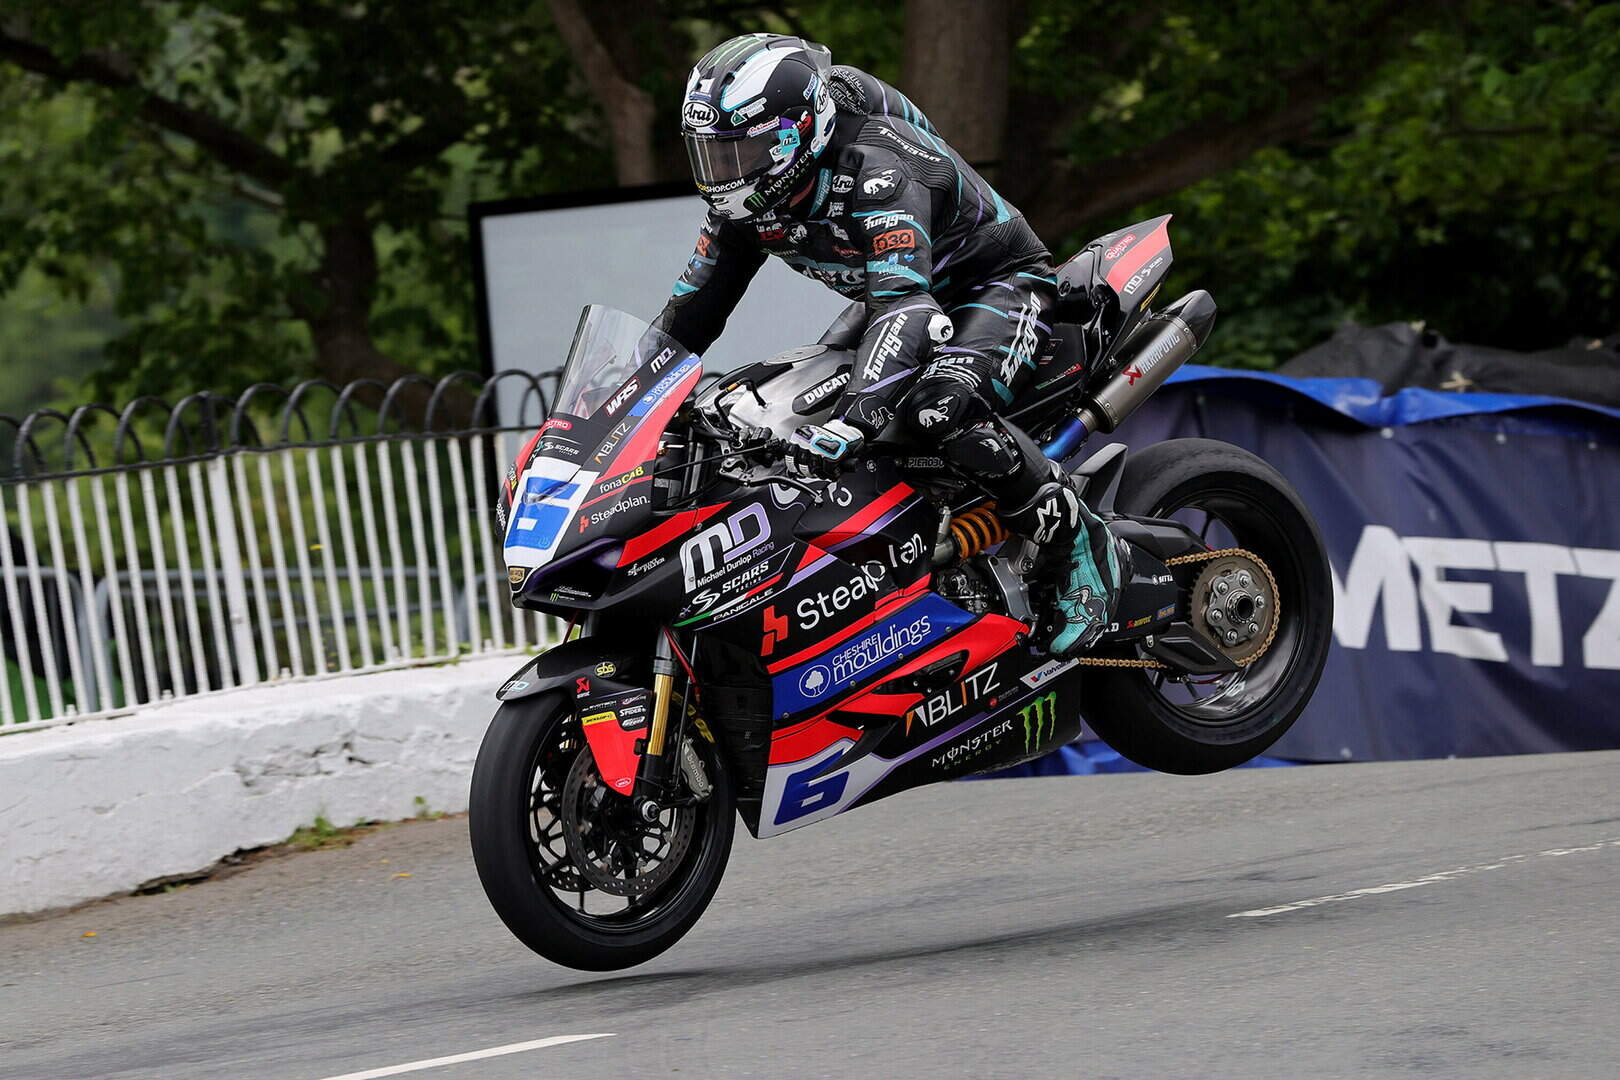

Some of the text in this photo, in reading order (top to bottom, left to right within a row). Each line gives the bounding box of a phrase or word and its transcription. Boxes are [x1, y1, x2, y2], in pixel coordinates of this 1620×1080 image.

[684, 104, 713, 122] Arai
[764, 149, 813, 196] MONSTER
[863, 204, 915, 232] Furygan
[862, 312, 908, 382] Furygan
[1000, 291, 1041, 388] Furygan
[606, 378, 639, 416] WRS
[804, 372, 851, 405] DUCATI
[599, 466, 645, 493] fonaCAB
[591, 495, 651, 525] Steadplan.
[697, 541, 775, 588] Michael Dunlop Racing
[722, 561, 769, 594] SCARS
[713, 588, 774, 621] PANIGALE
[832, 634, 878, 666] CHESHIRE
[833, 616, 932, 682] mouldings
[596, 663, 615, 676] sbs
[619, 705, 643, 717] SPIDER
[931, 719, 1014, 768] MONSTER
[687, 753, 704, 788] brembo
[774, 747, 850, 826] 6
